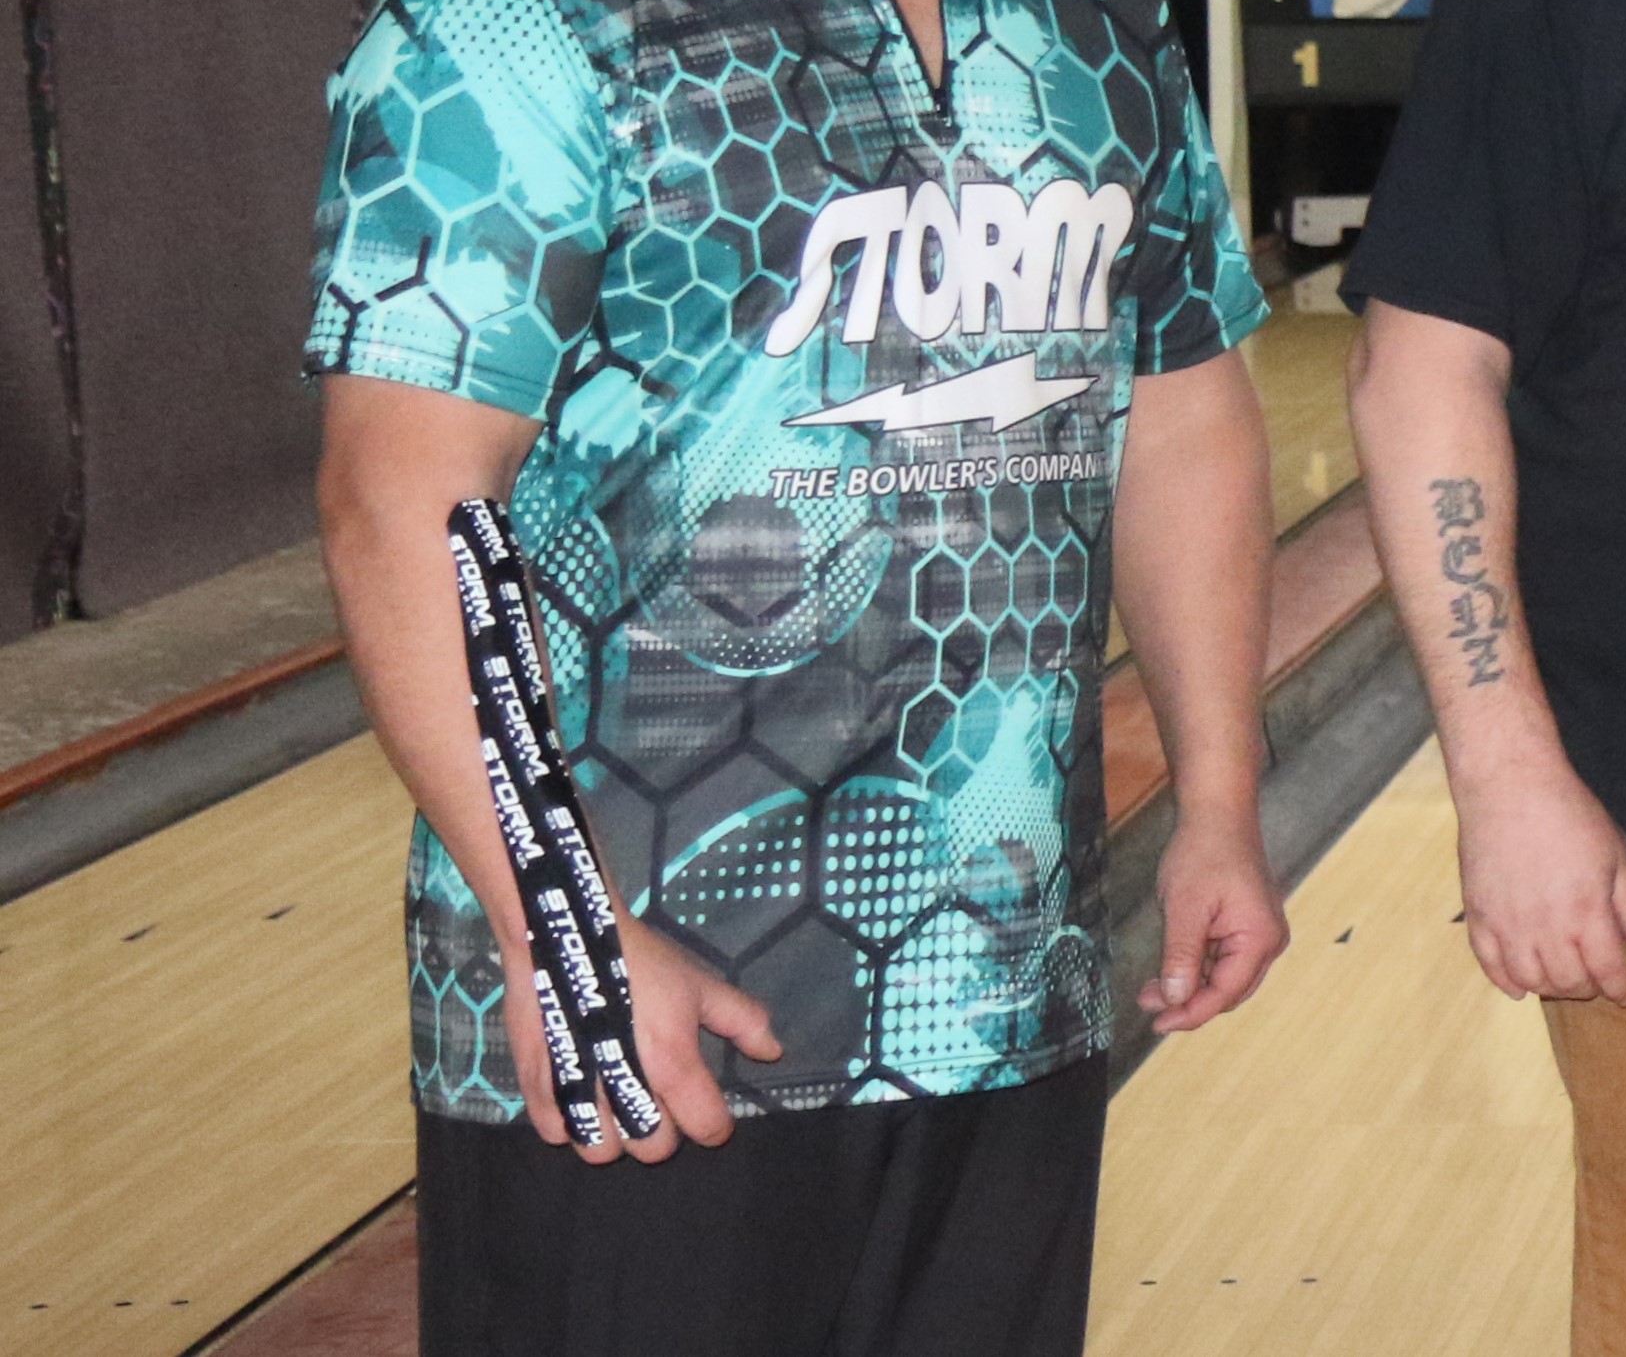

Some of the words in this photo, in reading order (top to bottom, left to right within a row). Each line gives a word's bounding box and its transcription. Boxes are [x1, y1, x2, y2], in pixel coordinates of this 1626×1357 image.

[1293, 41, 1320, 88] 1
[764, 180, 1134, 357] STORM
[770, 469, 839, 499] THE
[848, 459, 997, 496] BOWLER'S
[1005, 452, 1103, 485] COMPAN
[505, 582, 547, 695] STORM
[490, 656, 550, 778] STORM
[483, 738, 545, 862] STORM
[552, 806, 616, 927] STORM
[545, 889, 607, 1009] STORM
[534, 970, 584, 1081] STORM
[600, 1038, 661, 1126] STORM
